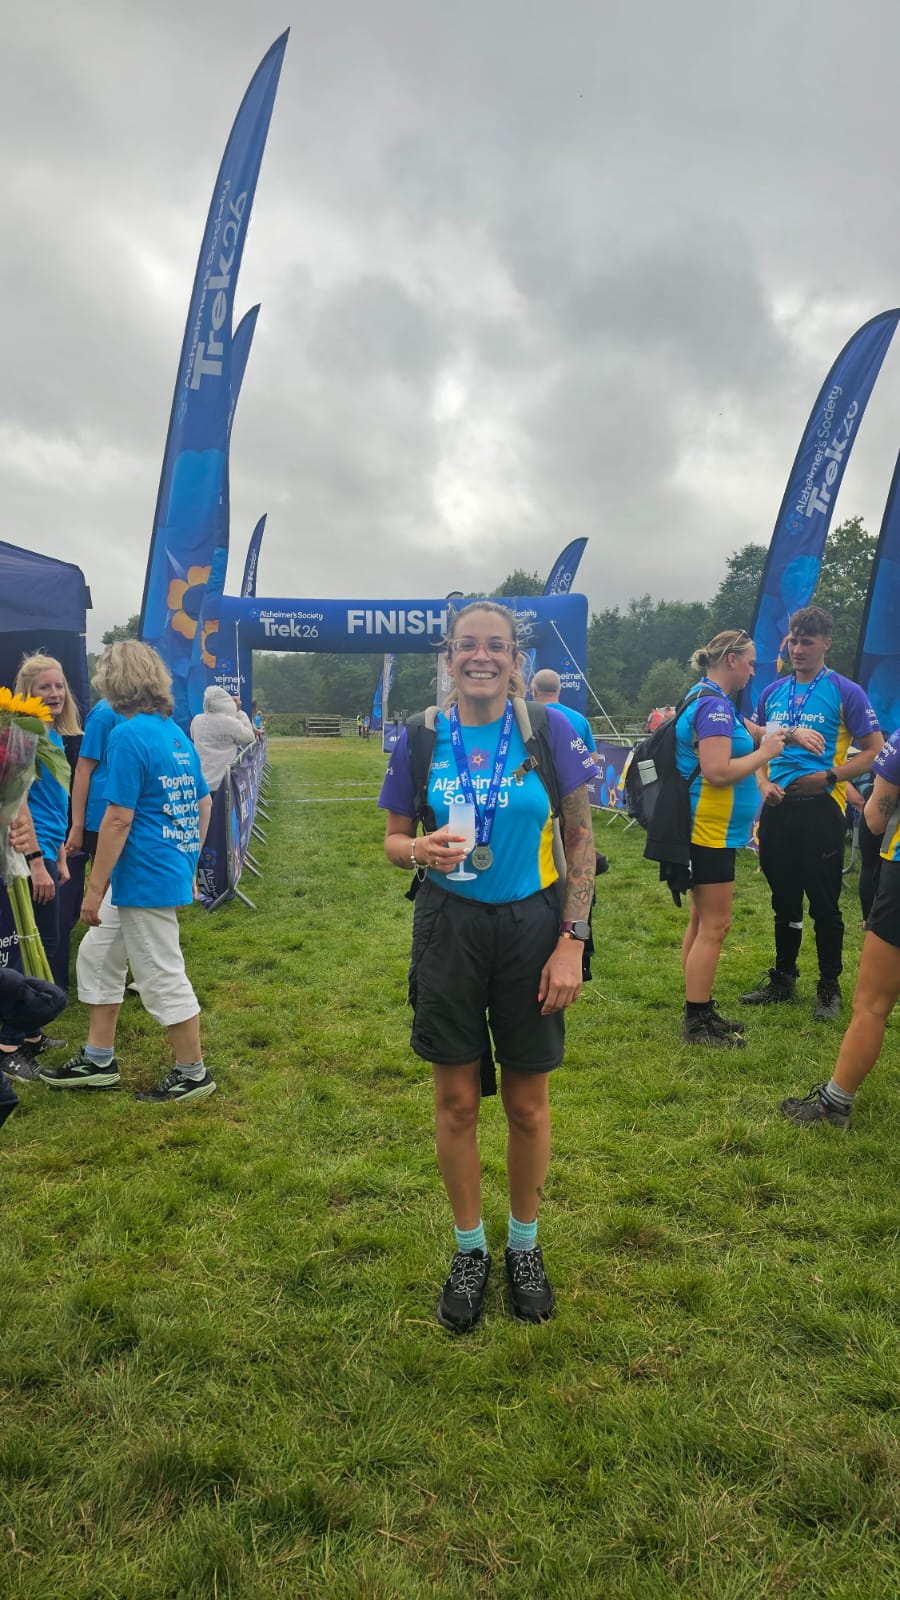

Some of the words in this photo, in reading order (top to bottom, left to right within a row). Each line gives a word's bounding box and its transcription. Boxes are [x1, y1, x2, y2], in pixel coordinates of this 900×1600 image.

[190, 190, 248, 391] Trek26
[795, 441, 829, 516] Alzheimer's
[816, 384, 843, 439] Society
[259, 610, 297, 620] Alzheimer's
[297, 611, 324, 622] Society
[259, 617, 319, 638] Trek26
[347, 609, 448, 635] FINISH
[443, 790, 509, 808] Soiey
